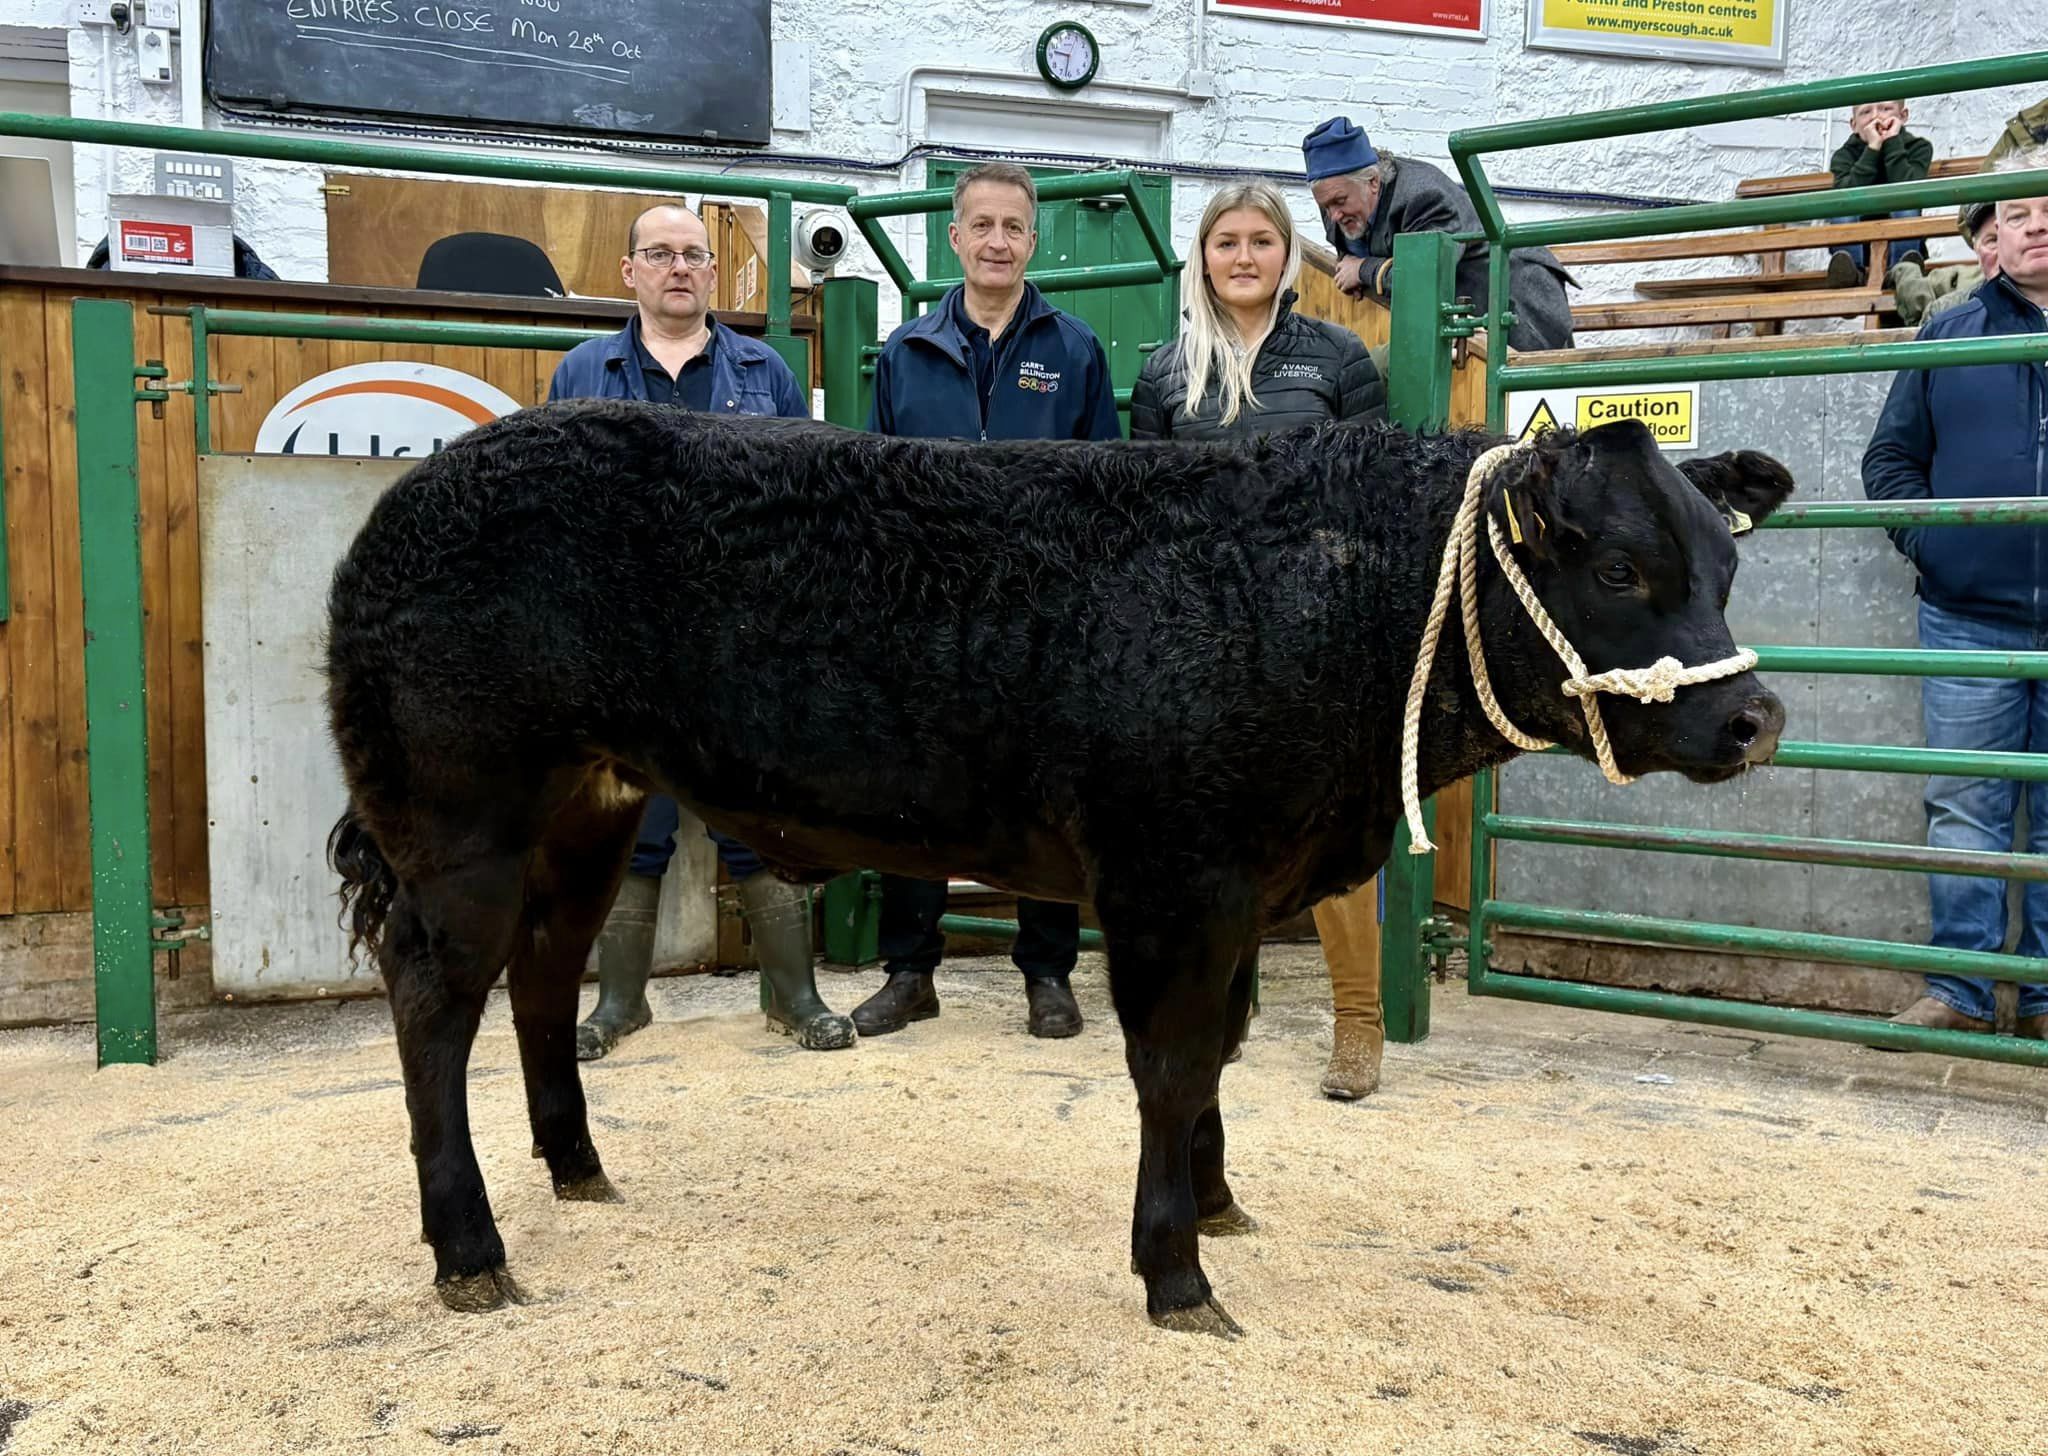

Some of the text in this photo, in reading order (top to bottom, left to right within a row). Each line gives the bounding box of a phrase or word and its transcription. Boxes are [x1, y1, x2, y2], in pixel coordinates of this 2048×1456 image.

[1622, 0, 1648, 8] and
[1653, 0, 1705, 15] Preston
[1708, 5, 1757, 19] centres
[1586, 14, 1734, 38] www.myerscough.ac.uk
[511, 17, 559, 48] Mon
[611, 40, 642, 59] Oct
[1019, 368, 1061, 380] BILLINGTON
[1273, 370, 1323, 381] LIVESTOCK
[1588, 398, 1679, 419] Caution
